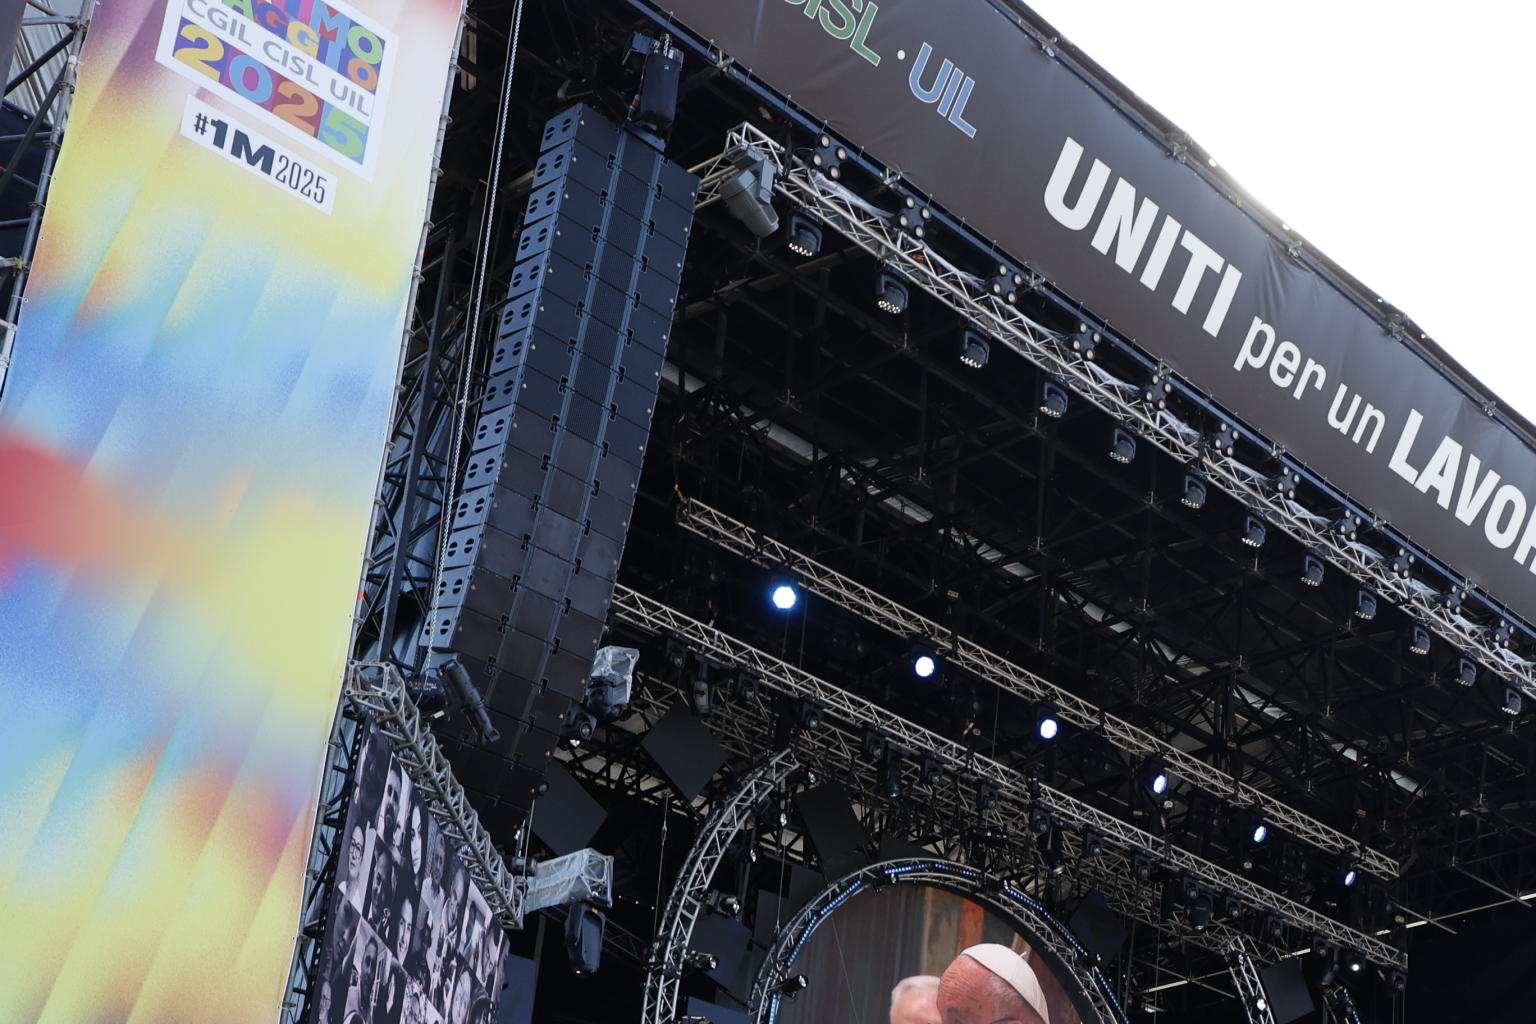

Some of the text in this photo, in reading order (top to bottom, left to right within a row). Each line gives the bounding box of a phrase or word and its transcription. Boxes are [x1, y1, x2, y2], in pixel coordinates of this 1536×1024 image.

[173, 24, 366, 159] 2025
[187, 0, 370, 118] CGIL CISL UIL
[908, 41, 977, 139] UIL
[1044, 136, 1243, 338] UNITI
[1233, 315, 1327, 401] per
[1327, 383, 1386, 454] un
